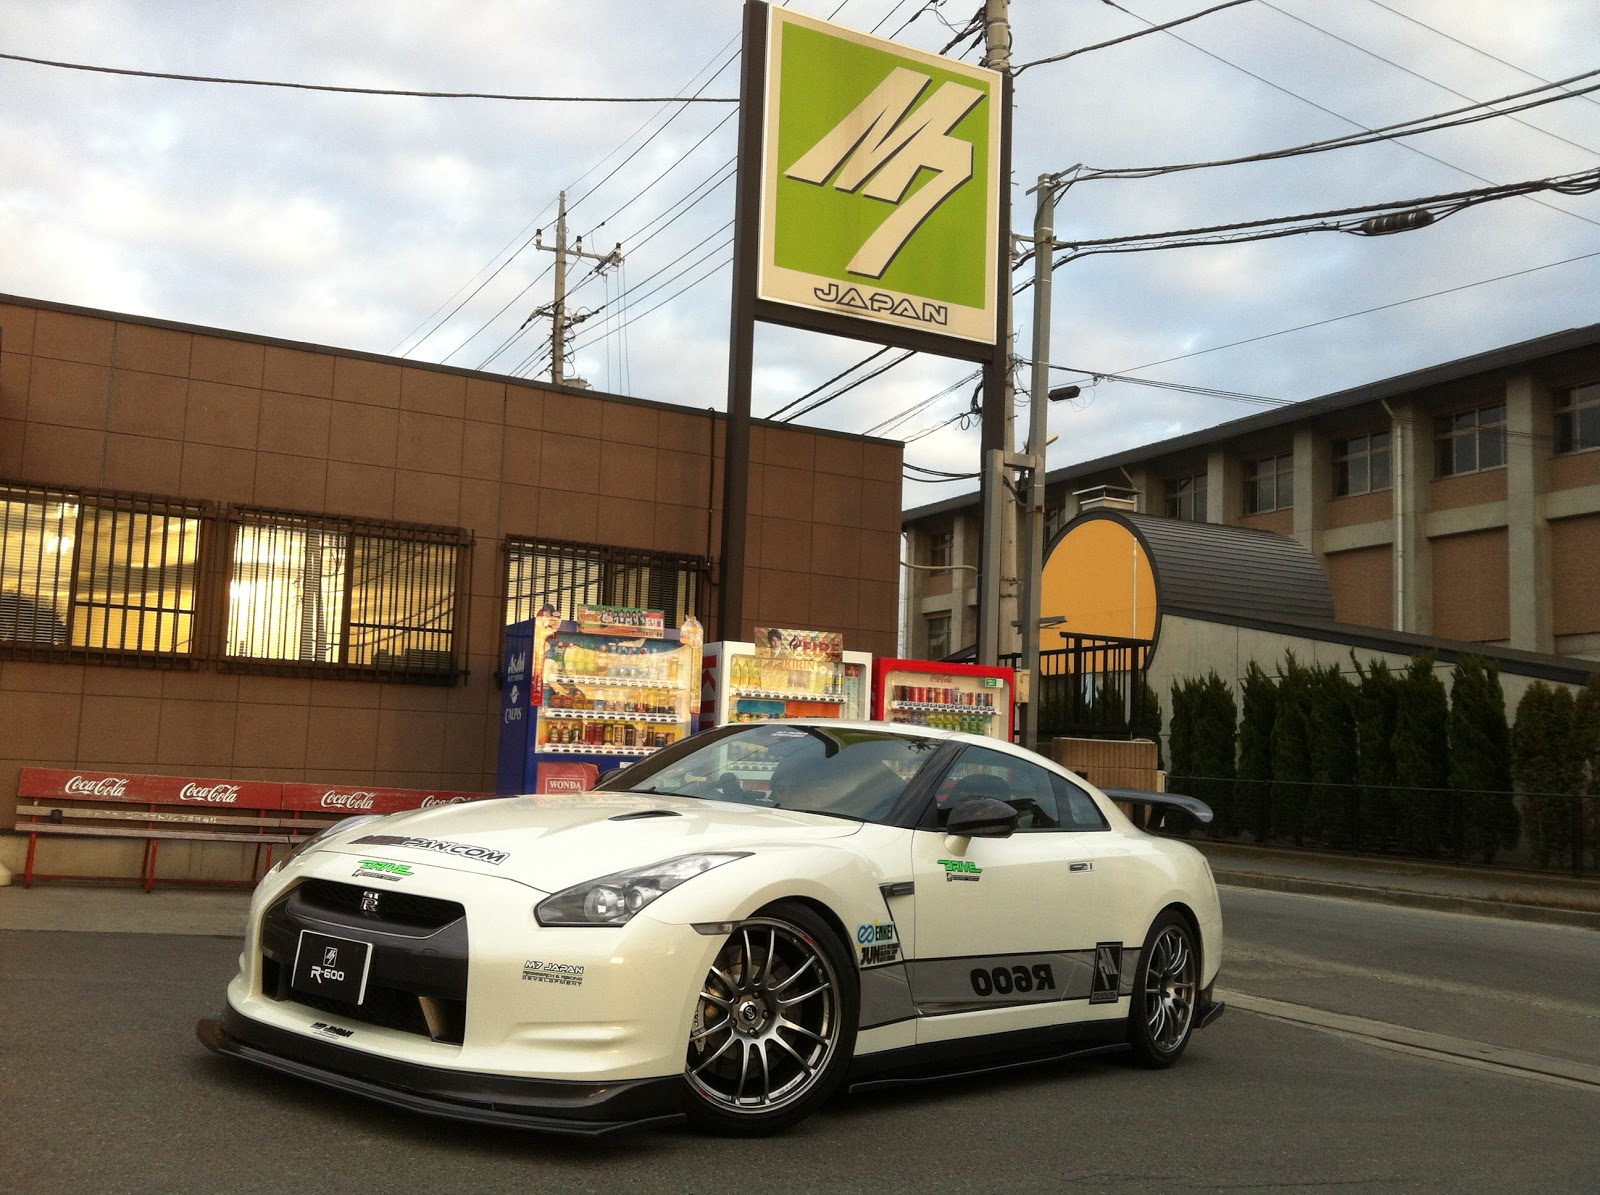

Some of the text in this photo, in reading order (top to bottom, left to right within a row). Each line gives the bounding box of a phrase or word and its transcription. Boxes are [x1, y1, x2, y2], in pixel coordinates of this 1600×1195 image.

[814, 283, 948, 326] JAPAN
[783, 659, 817, 671] KIRIN
[65, 775, 130, 797] Coca-Cola
[179, 782, 242, 803] Coca-Cola
[549, 780, 581, 790] WONDA
[320, 789, 377, 810] Coca-Cola
[875, 924, 893, 941] ENKEI
[860, 946, 880, 966] JUN
[310, 965, 345, 984] R-600
[524, 960, 584, 975] M7 JAPAN
[522, 974, 583, 987] DEVELOPMENT
